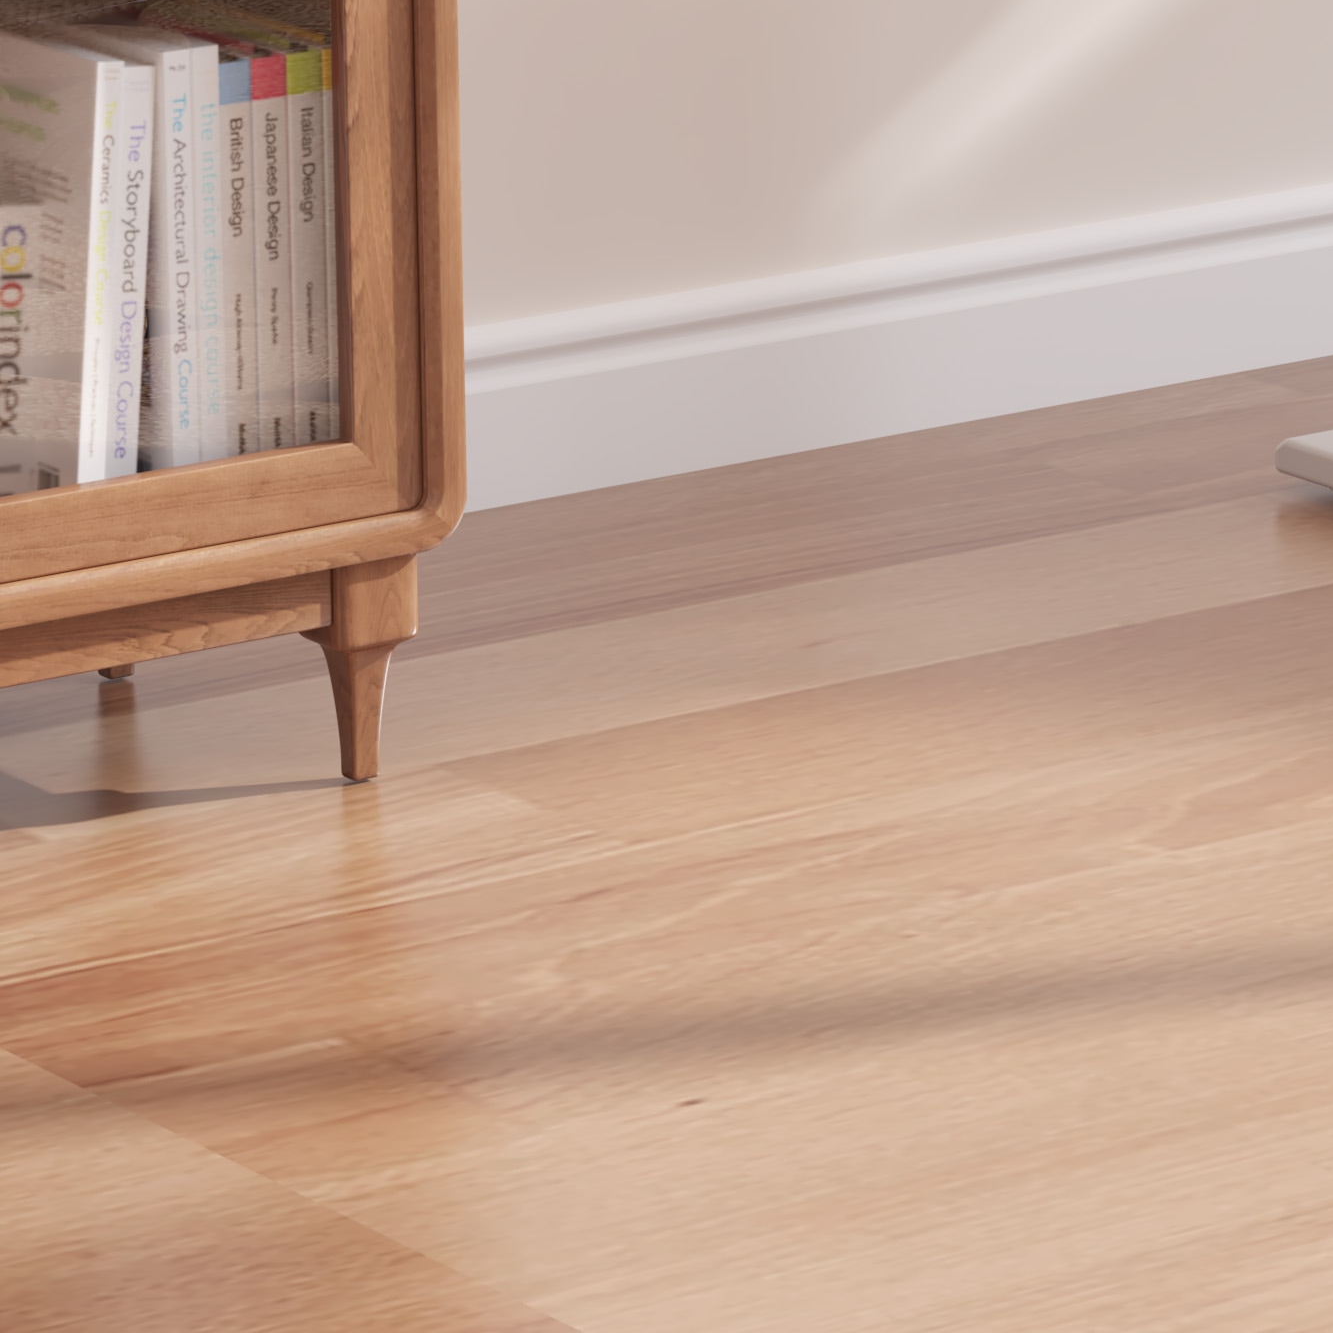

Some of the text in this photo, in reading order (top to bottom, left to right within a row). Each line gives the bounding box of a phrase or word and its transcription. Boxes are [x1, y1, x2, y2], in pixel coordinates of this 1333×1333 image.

[99, 135, 115, 204] Ceramics
[228, 117, 246, 237] British Design
[263, 112, 282, 261] Japanese Design
[300, 107, 317, 223] Italian Design
[0, 225, 34, 435] colorindex
[114, 119, 147, 459] The Storyboard Design Course
[172, 92, 193, 429] The Architectural Drawing Course
[199, 103, 223, 415] the interior design course
